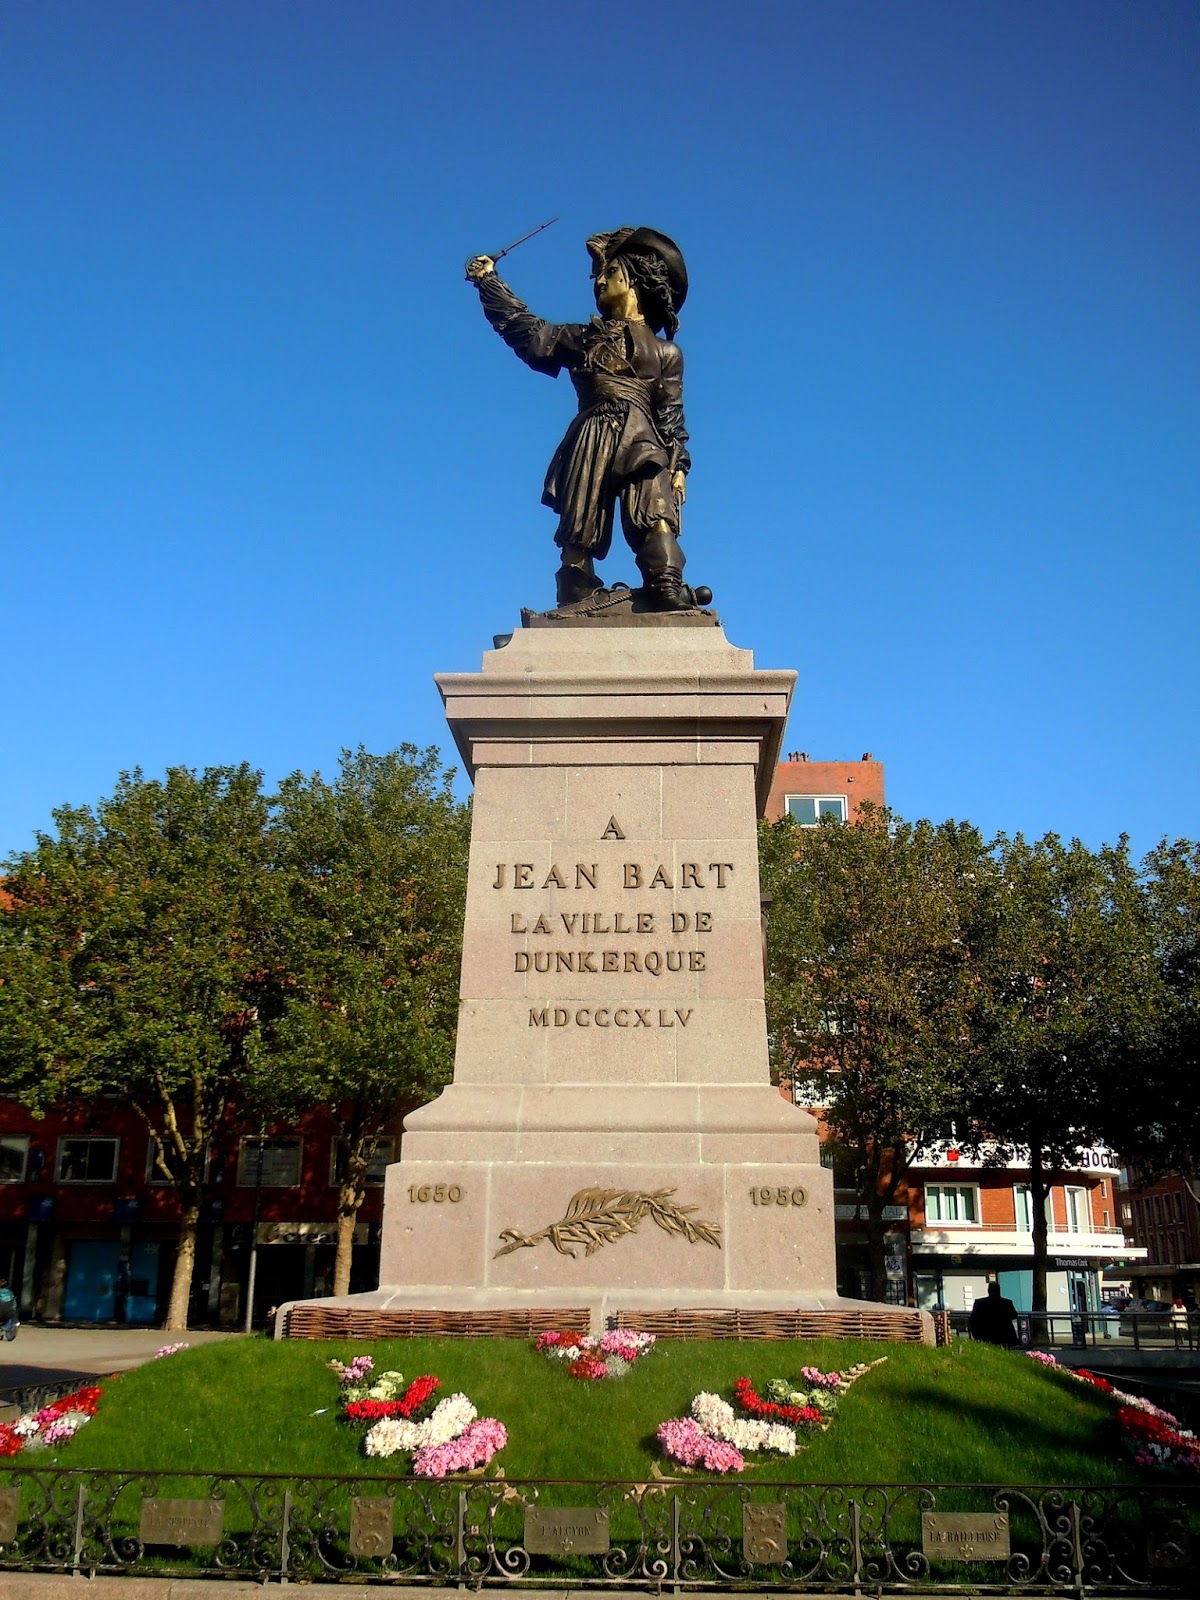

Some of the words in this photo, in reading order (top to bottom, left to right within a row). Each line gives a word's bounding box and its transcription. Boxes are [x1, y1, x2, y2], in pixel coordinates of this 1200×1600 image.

[601, 815, 626, 839] A
[492, 863, 599, 890] JEAN
[622, 862, 734, 889] BART
[510, 913, 551, 934] LA
[560, 912, 654, 935] VILLE
[671, 911, 713, 933] DE
[514, 950, 707, 976] DUNKERQUE
[528, 1007, 695, 1028] MDCCCXLV
[407, 1183, 464, 1203] 1650
[749, 1186, 808, 1206] 1950
[1055, 1257, 1077, 1267] Thomas
[541, 1525, 593, 1537] L'ALCYON
